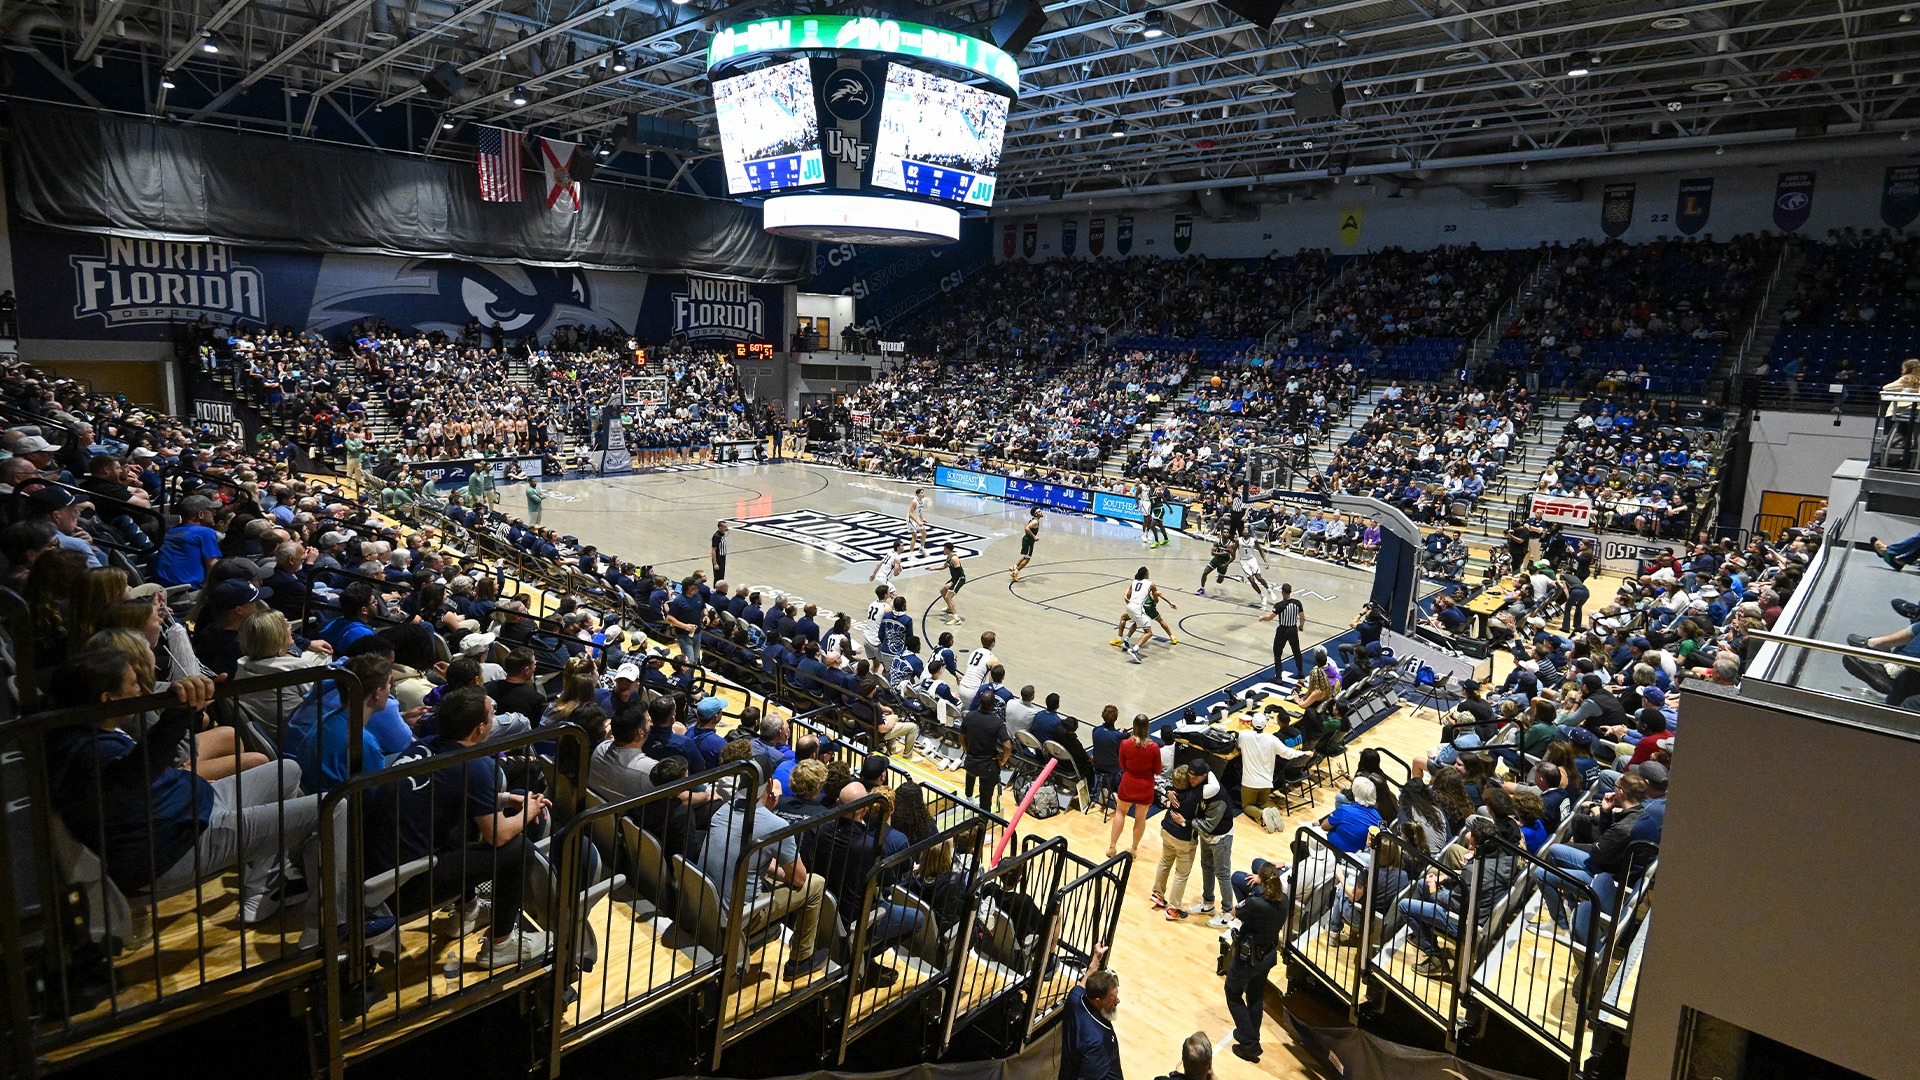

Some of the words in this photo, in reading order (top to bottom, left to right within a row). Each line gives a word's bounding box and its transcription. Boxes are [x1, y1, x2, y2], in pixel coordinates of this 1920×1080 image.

[827, 129, 871, 171] UNF
[803, 158, 822, 180] JU
[972, 182, 993, 202] JU
[1683, 195, 1701, 215] L
[1651, 214, 1669, 222] 22
[1175, 227, 1191, 238] JU
[1444, 224, 1457, 232] 23
[109, 237, 228, 273] NORTH
[940, 268, 964, 293] CSI
[77, 260, 261, 318] FLORIDA
[689, 279, 747, 303] NORTH
[122, 309, 223, 321] OSPREYS
[674, 296, 762, 335] FLORIDA
[693, 329, 744, 337] OSPREYS
[737, 347, 745, 356] 62
[1460, 370, 1466, 381] 2
[1645, 378, 1650, 390] 1
[196, 401, 232, 423] NORTH
[946, 470, 979, 483] SOUTHEAST
[1063, 489, 1074, 498] JU
[1082, 492, 1089, 500] 51
[1532, 500, 1589, 519] ESPN
[843, 511, 976, 546] NORTH
[757, 526, 861, 558] OSPREYS
[1134, 582, 1143, 592] 0
[867, 606, 878, 621] 32
[827, 637, 836, 652] 12
[969, 651, 984, 666] 13
